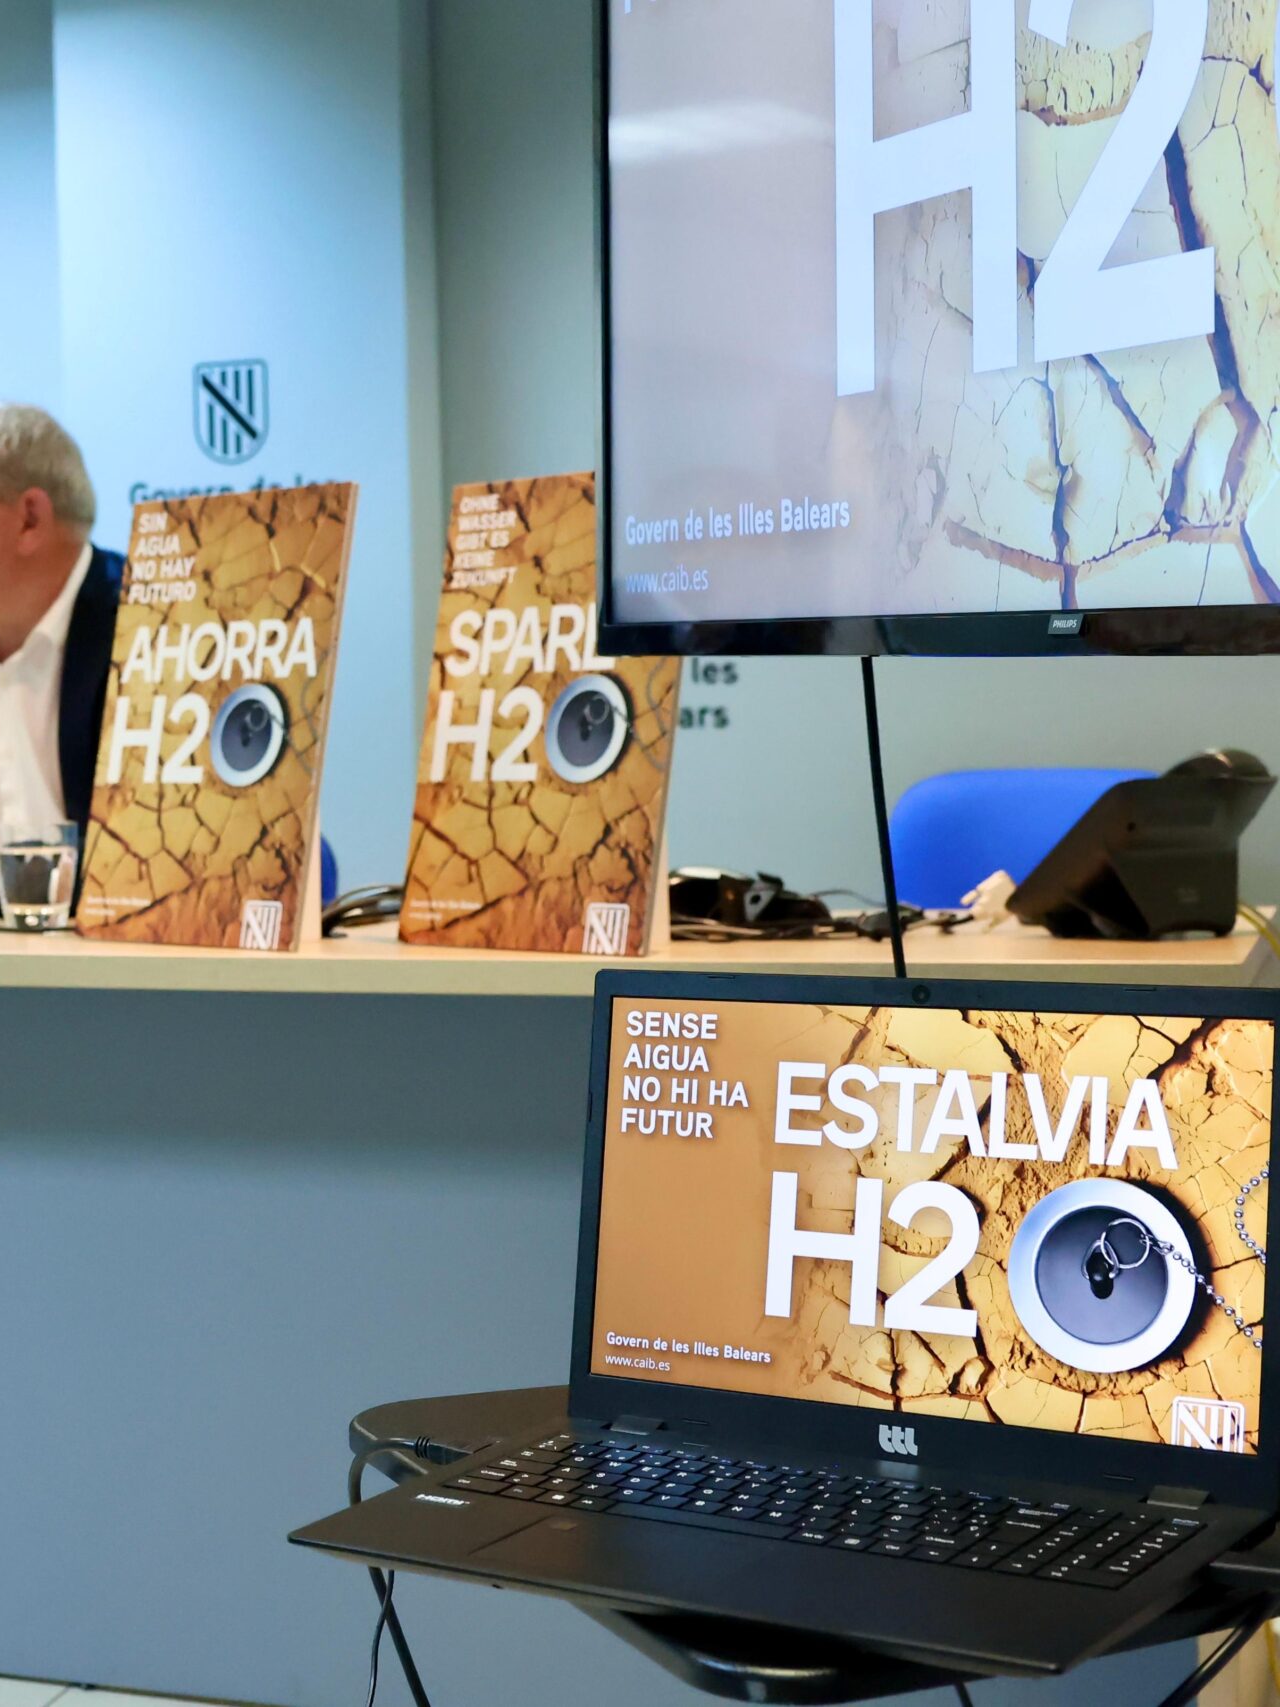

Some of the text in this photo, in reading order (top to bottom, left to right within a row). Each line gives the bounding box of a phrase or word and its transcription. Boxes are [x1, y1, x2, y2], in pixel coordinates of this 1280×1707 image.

[138, 511, 168, 534] SIN
[458, 510, 517, 532] WASSER
[626, 496, 851, 546] Govern de les Illes Balears
[133, 533, 182, 558] AGUA
[131, 555, 197, 581] NO HAY
[625, 565, 709, 593] www.caib.es
[127, 580, 197, 605] FUTURO
[1052, 619, 1078, 629] PHILIPS
[120, 616, 317, 684] AHORRA
[626, 1010, 718, 1040] SENSE
[623, 1043, 710, 1073] AIGUA
[622, 1075, 750, 1108] NO HI HA
[621, 1107, 714, 1139] FUTUR
[775, 1060, 1178, 1170] ESTALVIA
[606, 1331, 772, 1364] Govern de les Illes Balears
[605, 1354, 671, 1372] www.caib.es
